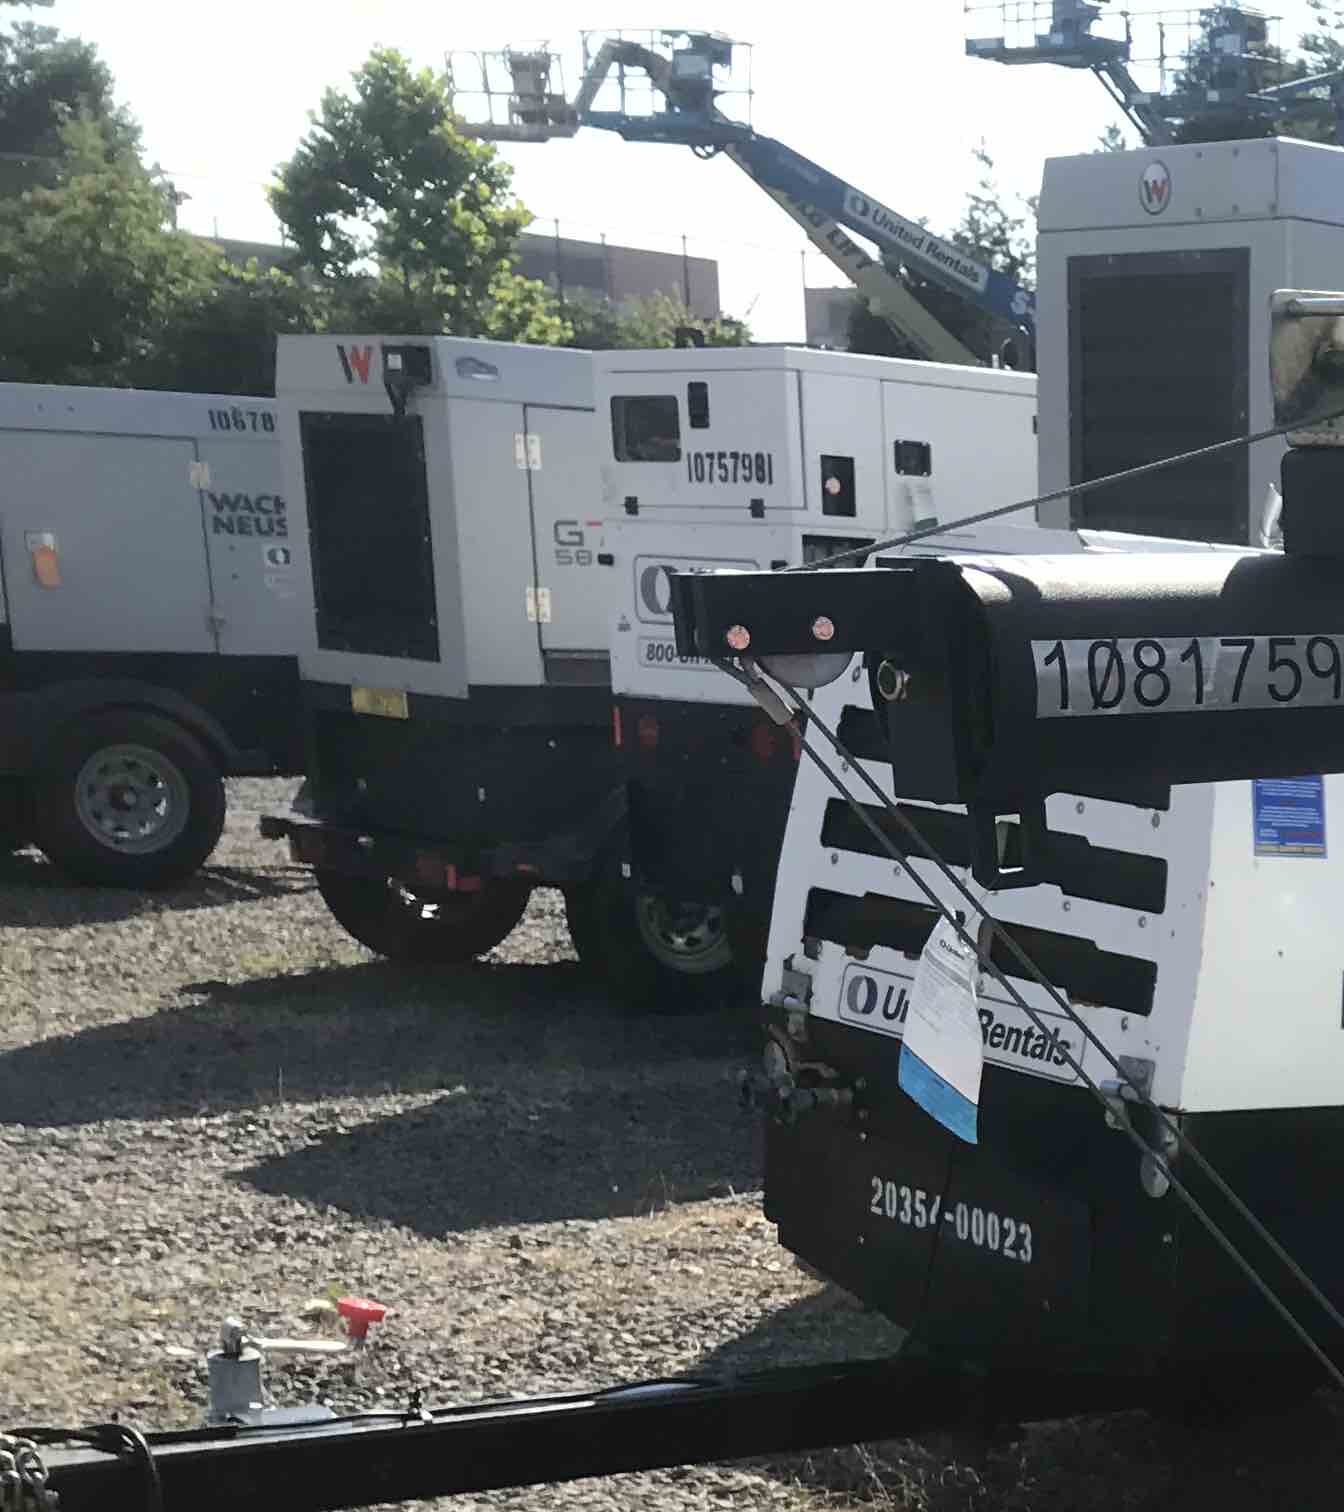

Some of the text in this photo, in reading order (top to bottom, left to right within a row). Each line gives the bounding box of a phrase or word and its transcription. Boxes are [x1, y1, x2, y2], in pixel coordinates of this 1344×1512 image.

[872, 207, 925, 251] United
[925, 240, 980, 284] Rentals
[687, 451, 774, 486] 10757981
[978, 1007, 1072, 1066] Rentals
